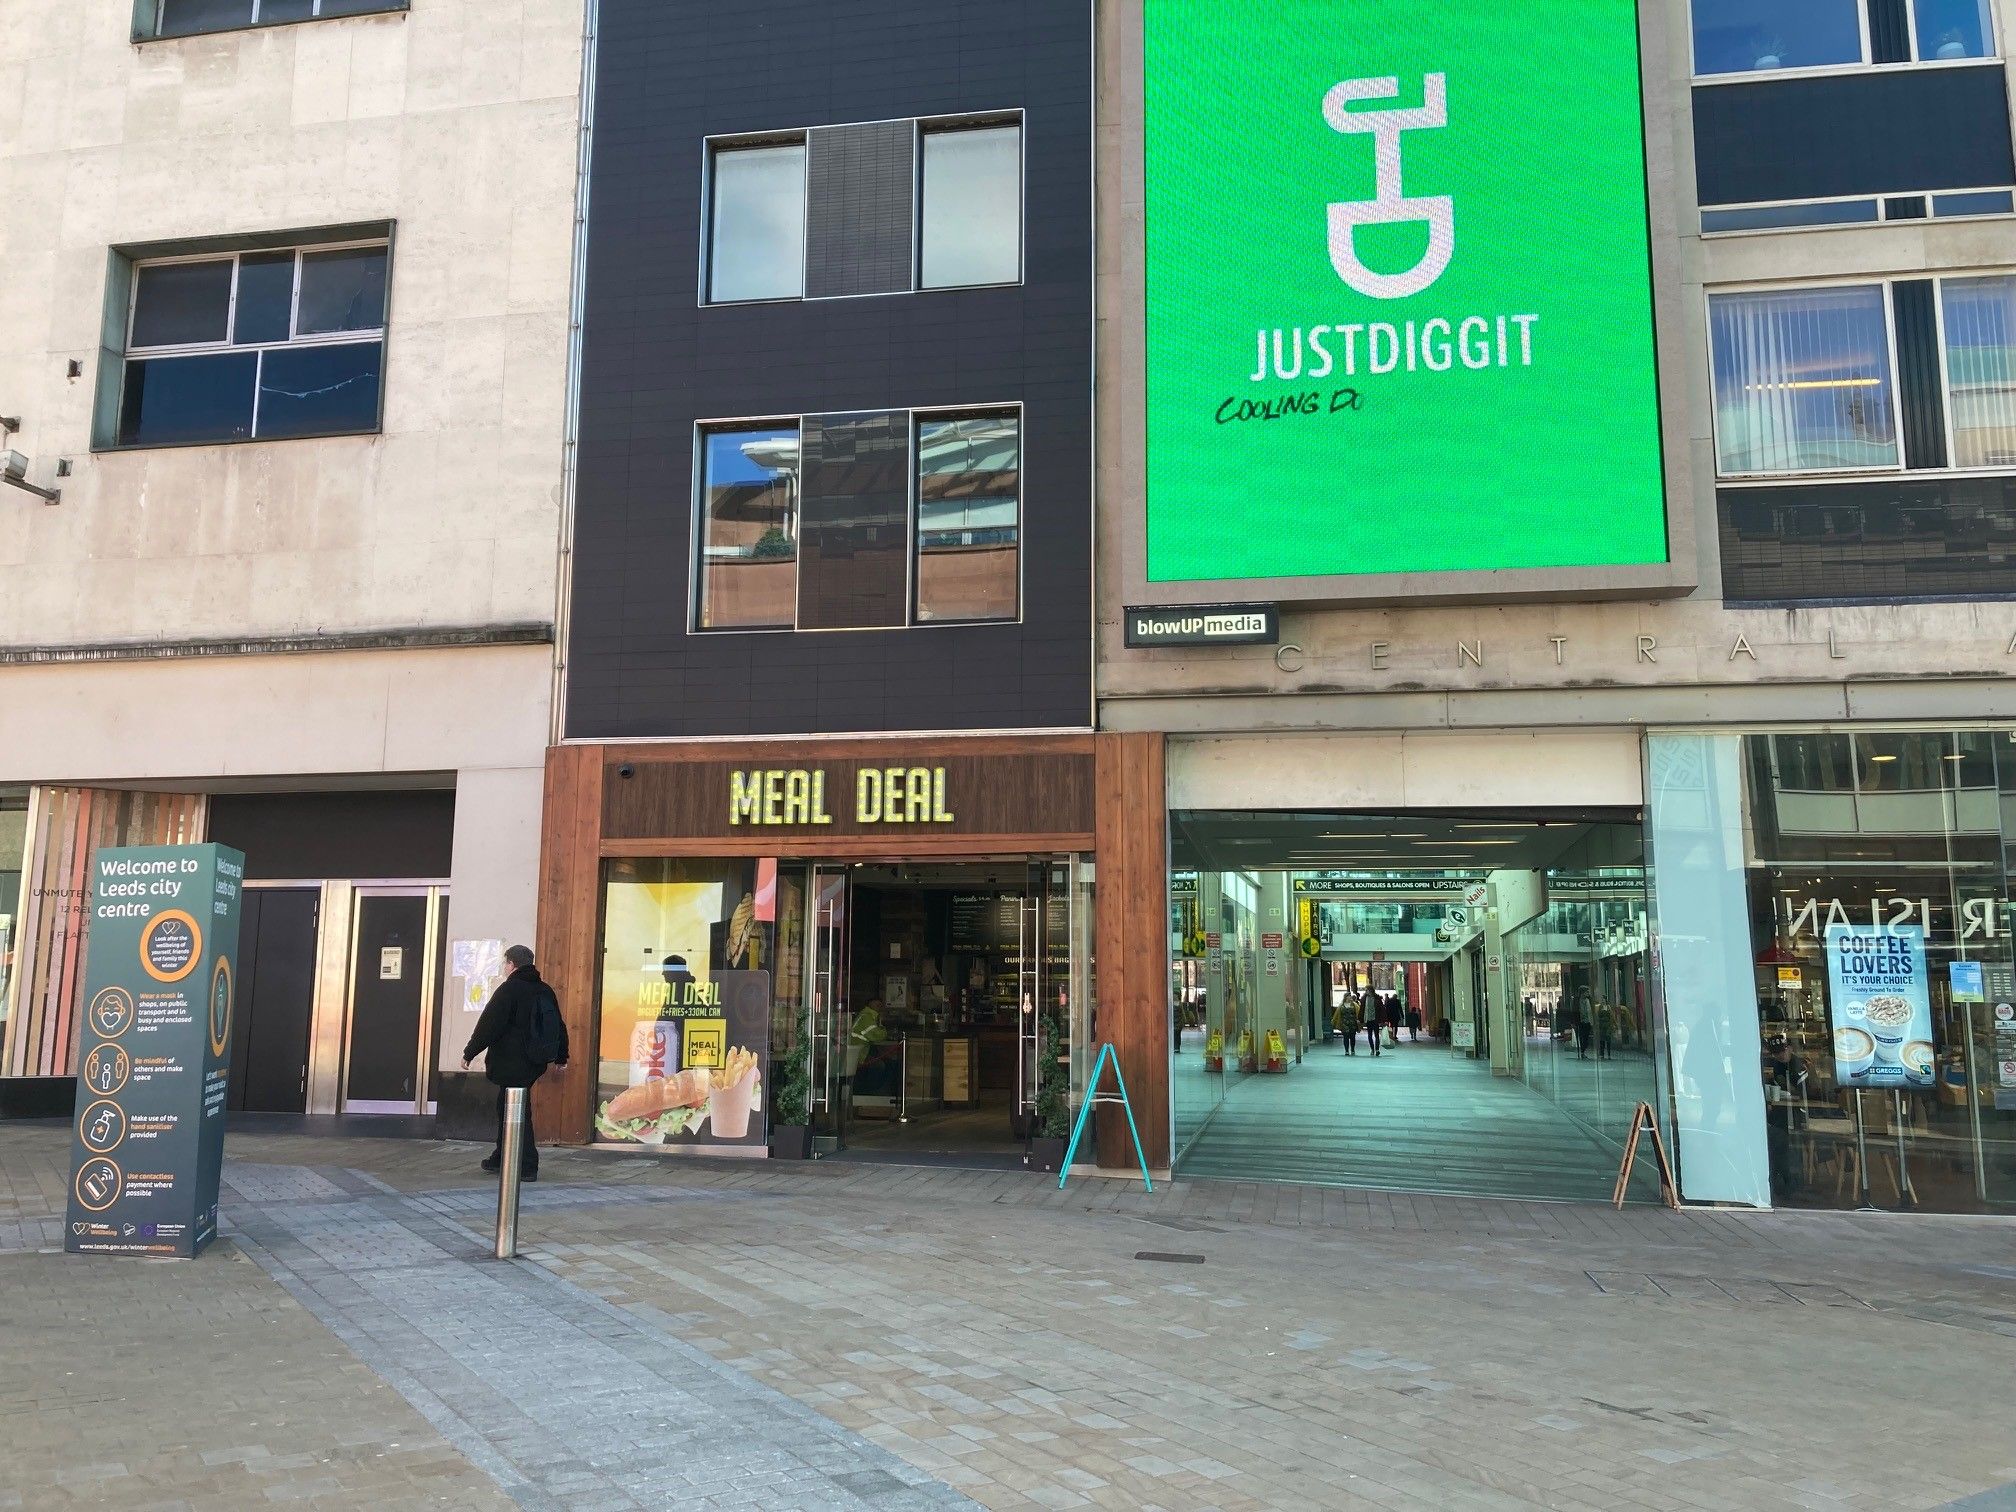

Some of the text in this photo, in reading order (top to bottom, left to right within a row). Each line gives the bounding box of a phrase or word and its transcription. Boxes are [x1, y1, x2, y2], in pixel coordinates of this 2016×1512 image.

[1249, 313, 1540, 382] JUSTDIGGIT
[1215, 391, 1320, 425] COOLING
[1275, 630, 1845, 672] CENTRAL
[728, 766, 955, 825] MEAL DEAL
[100, 858, 199, 876] Welcome to
[99, 878, 182, 897] Leeds city
[1309, 881, 1332, 889] MORE
[1466, 886, 1486, 905] Nails
[97, 902, 150, 918] centre
[1838, 935, 1912, 954] COFFEE
[1841, 956, 1913, 974] LOVERS
[1841, 975, 1913, 984] IT'S YOUR CHOICE
[638, 981, 722, 1005] MEAL DEAL
[708, 1007, 721, 1017] CAN
[691, 1041, 717, 1049] MEAL
[691, 1049, 717, 1057] DEAL
[168, 1056, 175, 1064] of
[130, 1131, 157, 1139] provided
